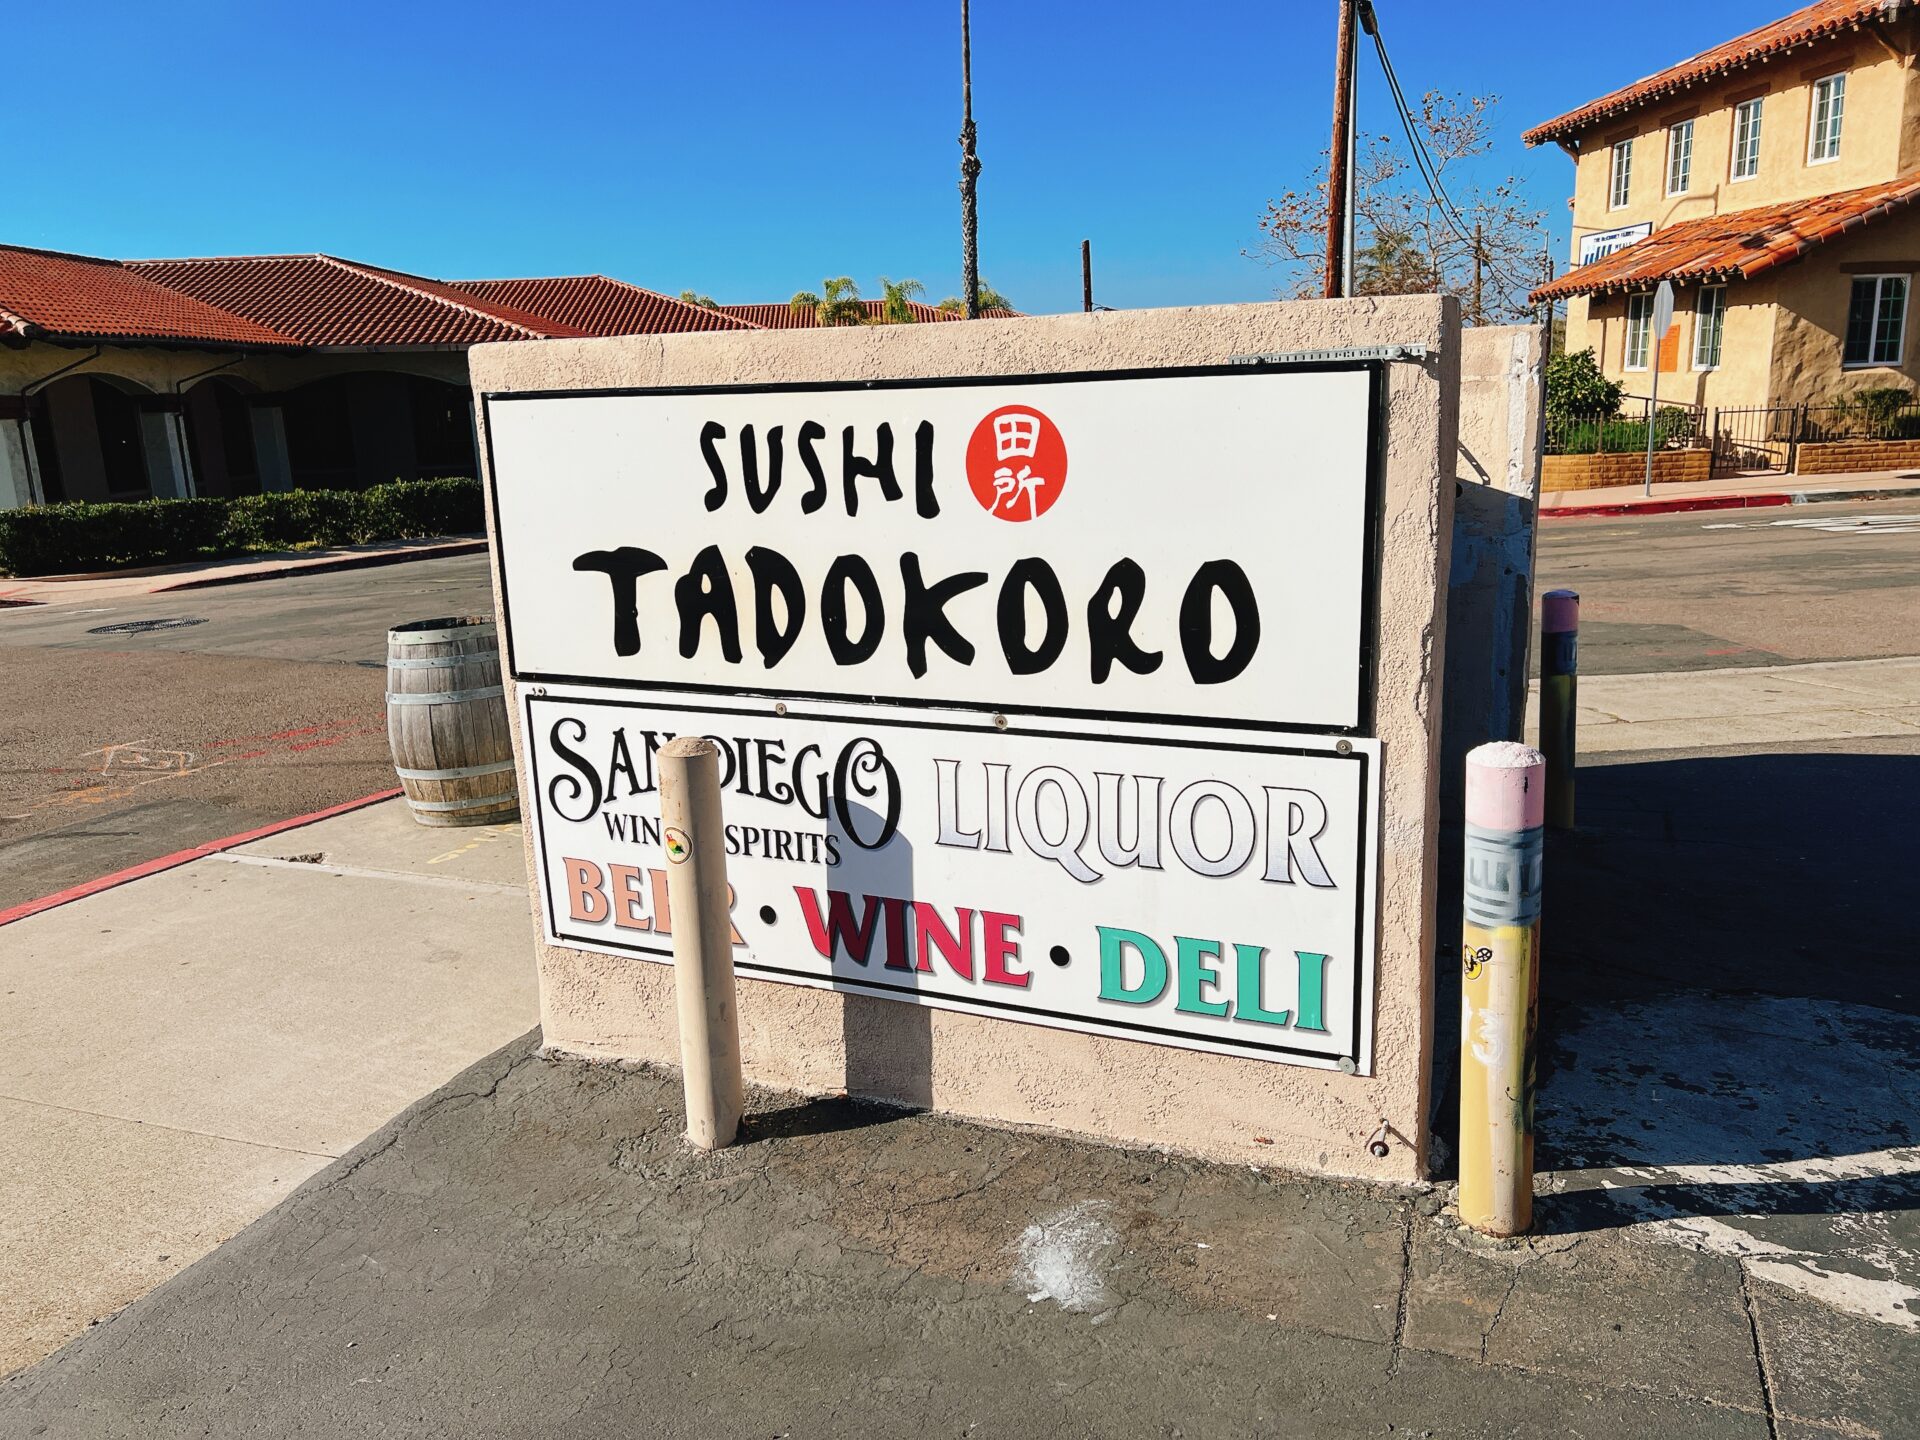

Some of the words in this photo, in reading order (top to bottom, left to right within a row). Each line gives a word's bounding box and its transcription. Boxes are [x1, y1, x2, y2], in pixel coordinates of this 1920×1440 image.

[700, 419, 940, 519] SUSHI
[991, 413, 1045, 520] 田所
[572, 544, 1261, 684] TADOKORO
[603, 811, 662, 846] WIN
[725, 824, 841, 866] SPIRITS
[933, 758, 1337, 888] LIQUOR
[794, 886, 1032, 989] WINE
[1095, 925, 1329, 1033] DELI
